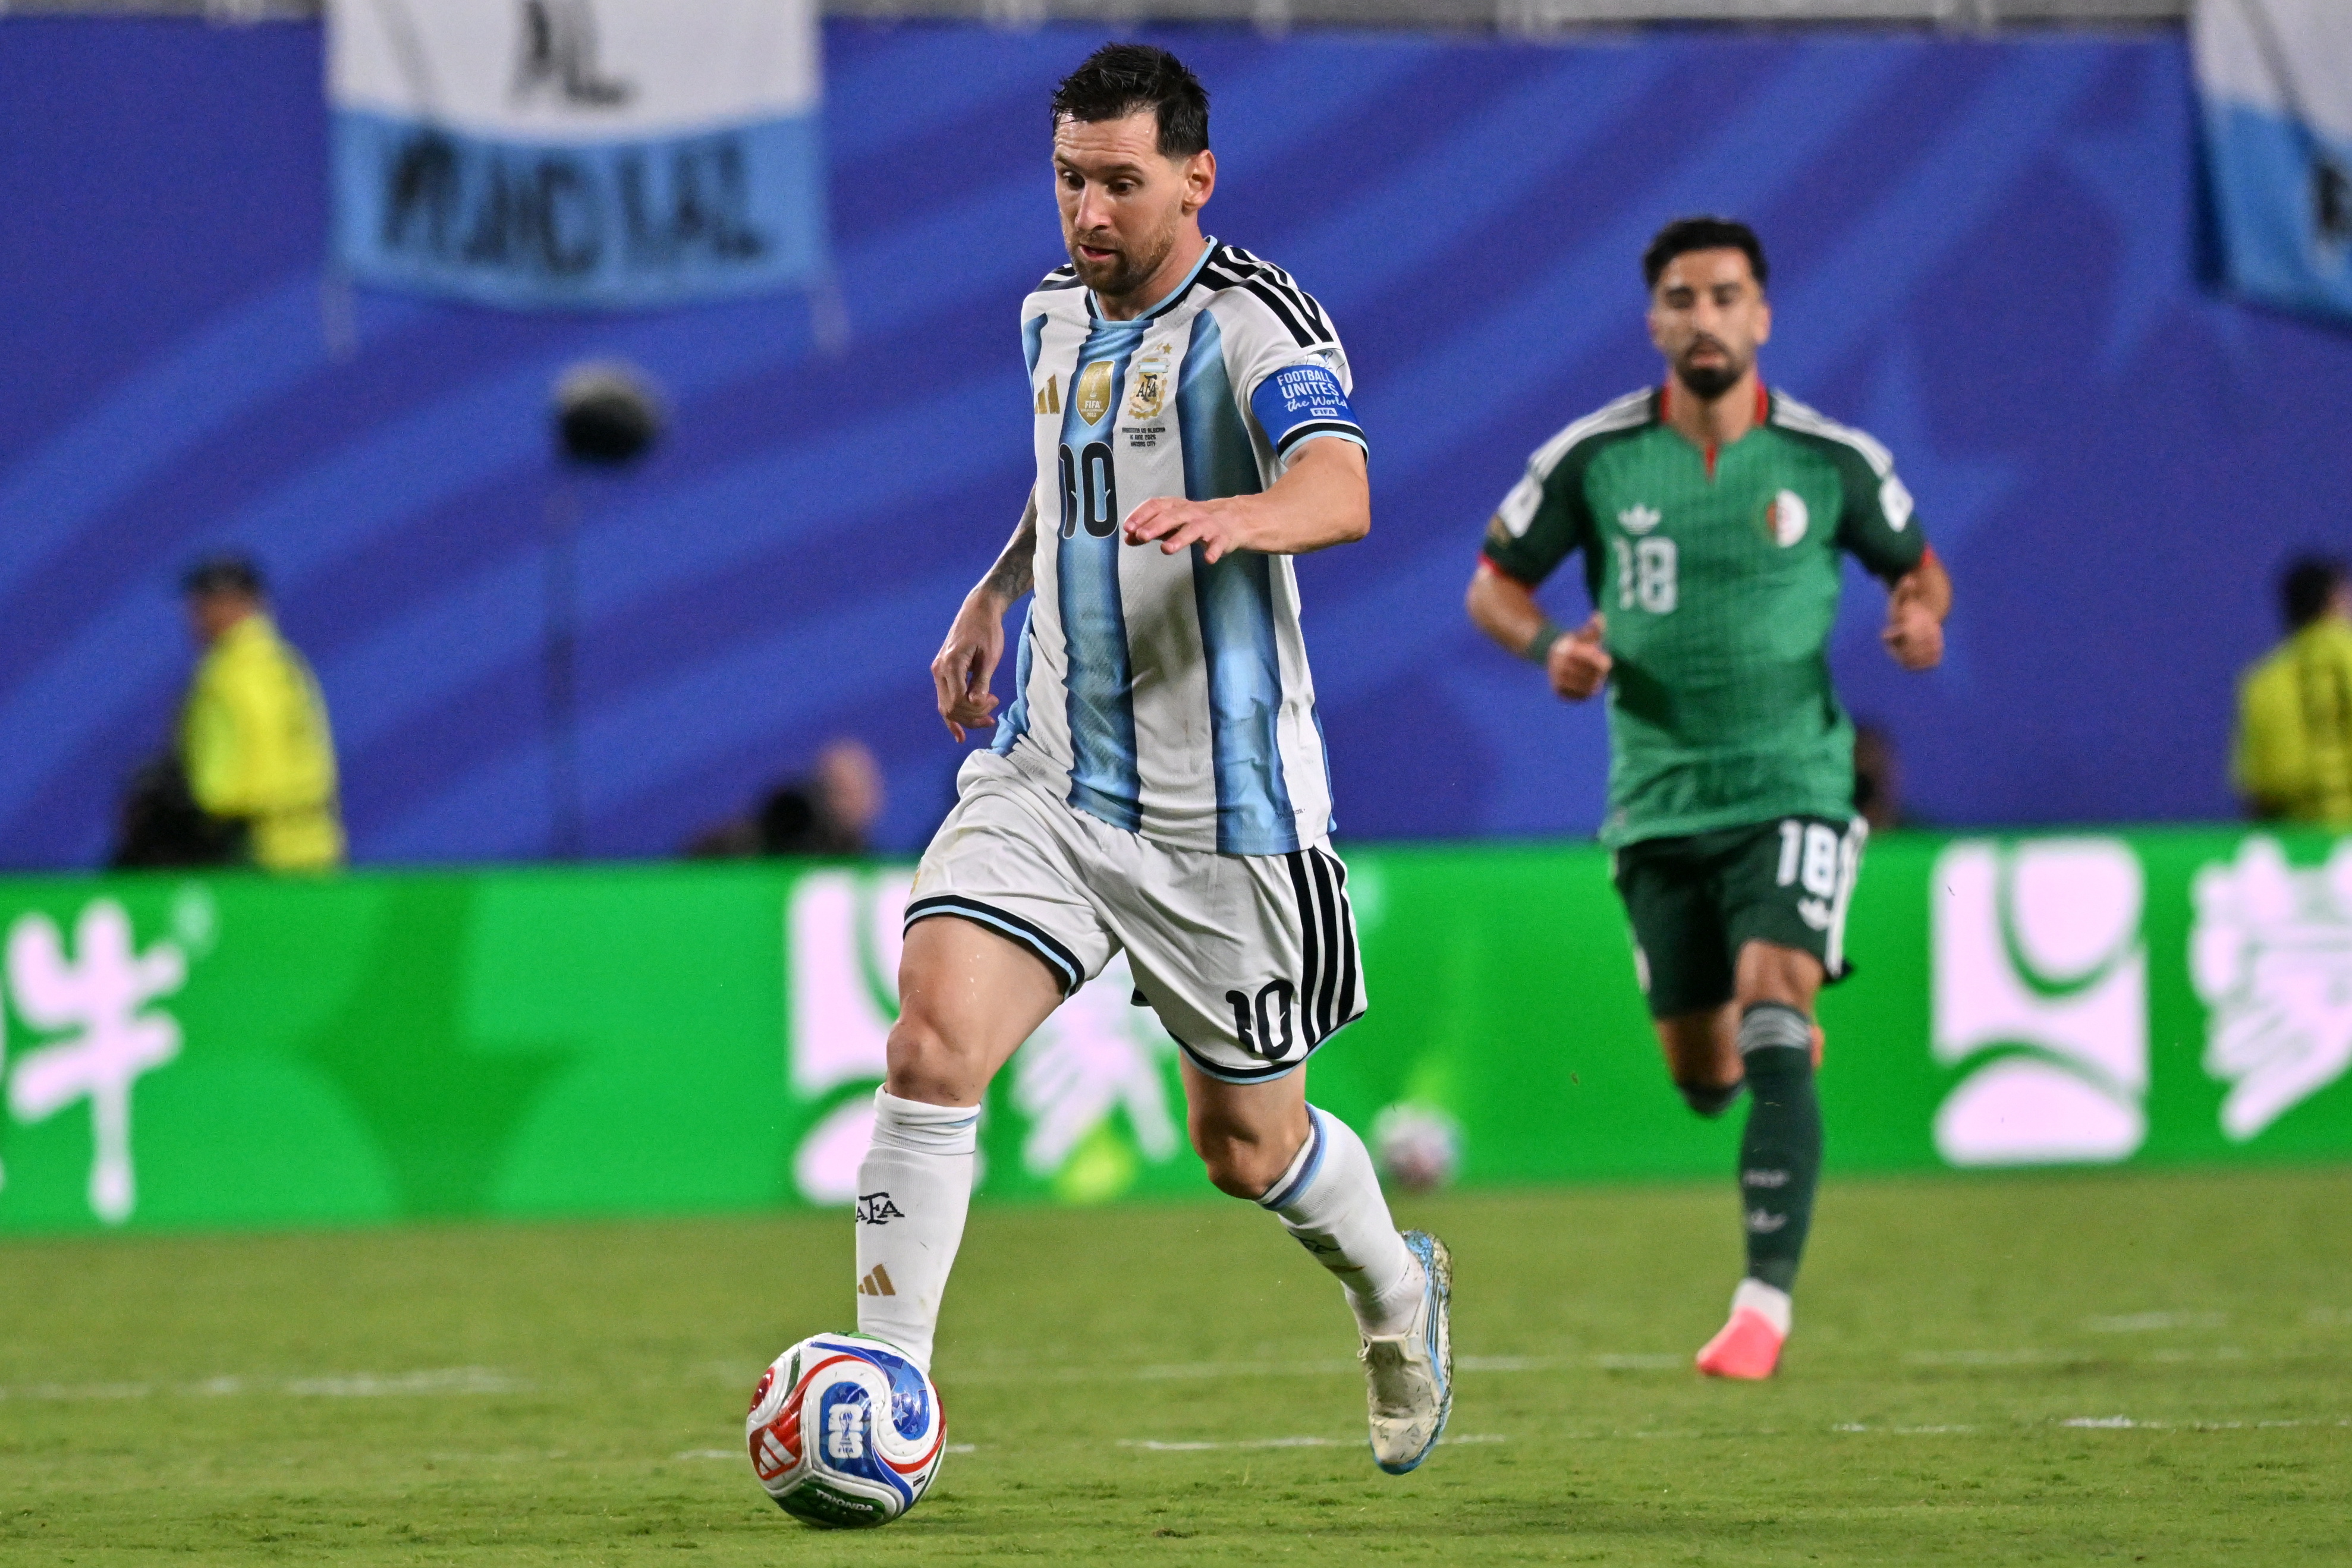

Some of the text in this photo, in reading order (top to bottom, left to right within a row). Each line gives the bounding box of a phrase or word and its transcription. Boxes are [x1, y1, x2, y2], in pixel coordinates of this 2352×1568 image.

[1136, 374, 1158, 402] AFA
[1276, 370, 1333, 386] FOOTBALL
[1281, 382, 1339, 399] UNITES
[1284, 395, 1348, 412] the World
[1058, 441, 1118, 540] 10
[1611, 535, 1678, 615] 18
[1776, 819, 1838, 899] 18
[1225, 978, 1294, 1060] 10
[855, 1191, 905, 1225] AFA
[816, 1488, 873, 1511] TRIONDA
